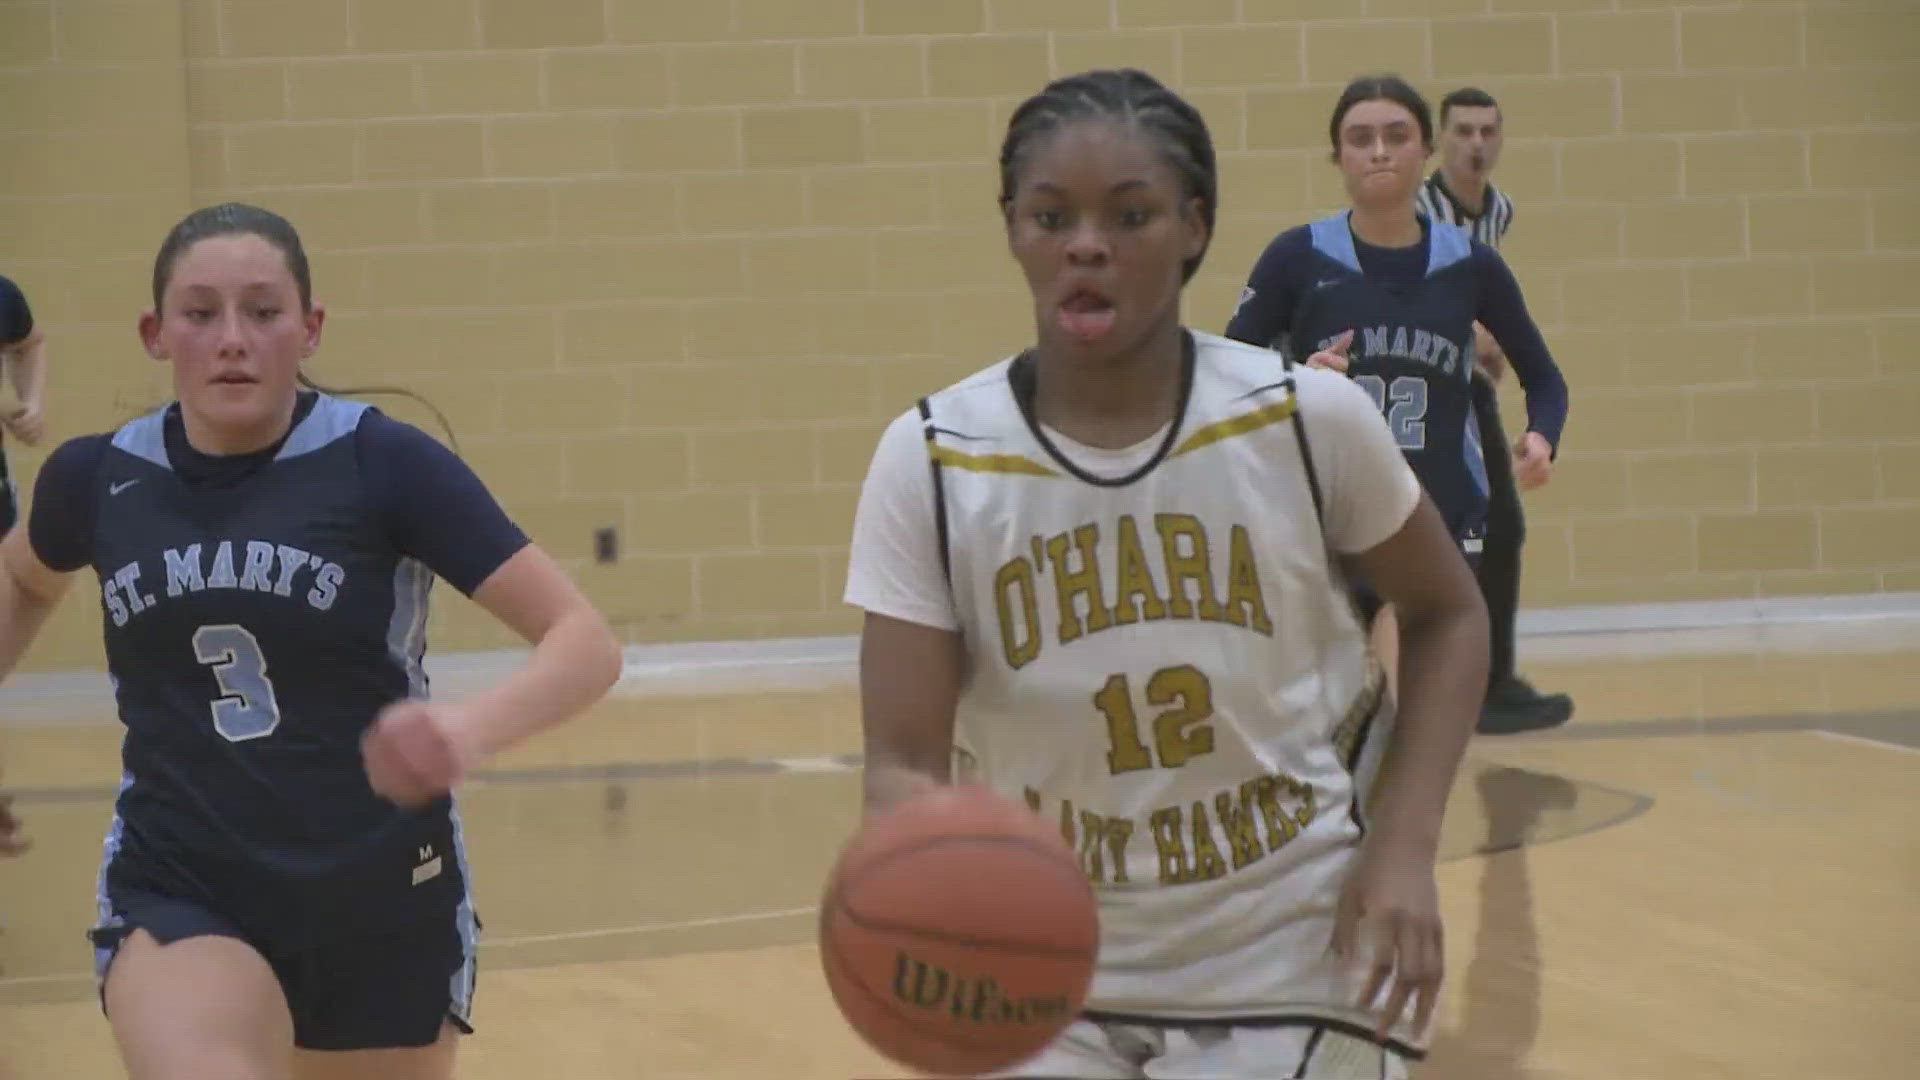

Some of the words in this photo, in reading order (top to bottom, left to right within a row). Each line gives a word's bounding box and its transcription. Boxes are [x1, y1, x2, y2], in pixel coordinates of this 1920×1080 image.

[104, 561, 157, 627] ST.
[163, 540, 346, 611] MARY'S
[993, 513, 1273, 671] O'HARA
[192, 623, 281, 742] 3
[1093, 664, 1215, 776] 12
[1023, 784, 1135, 884] DY
